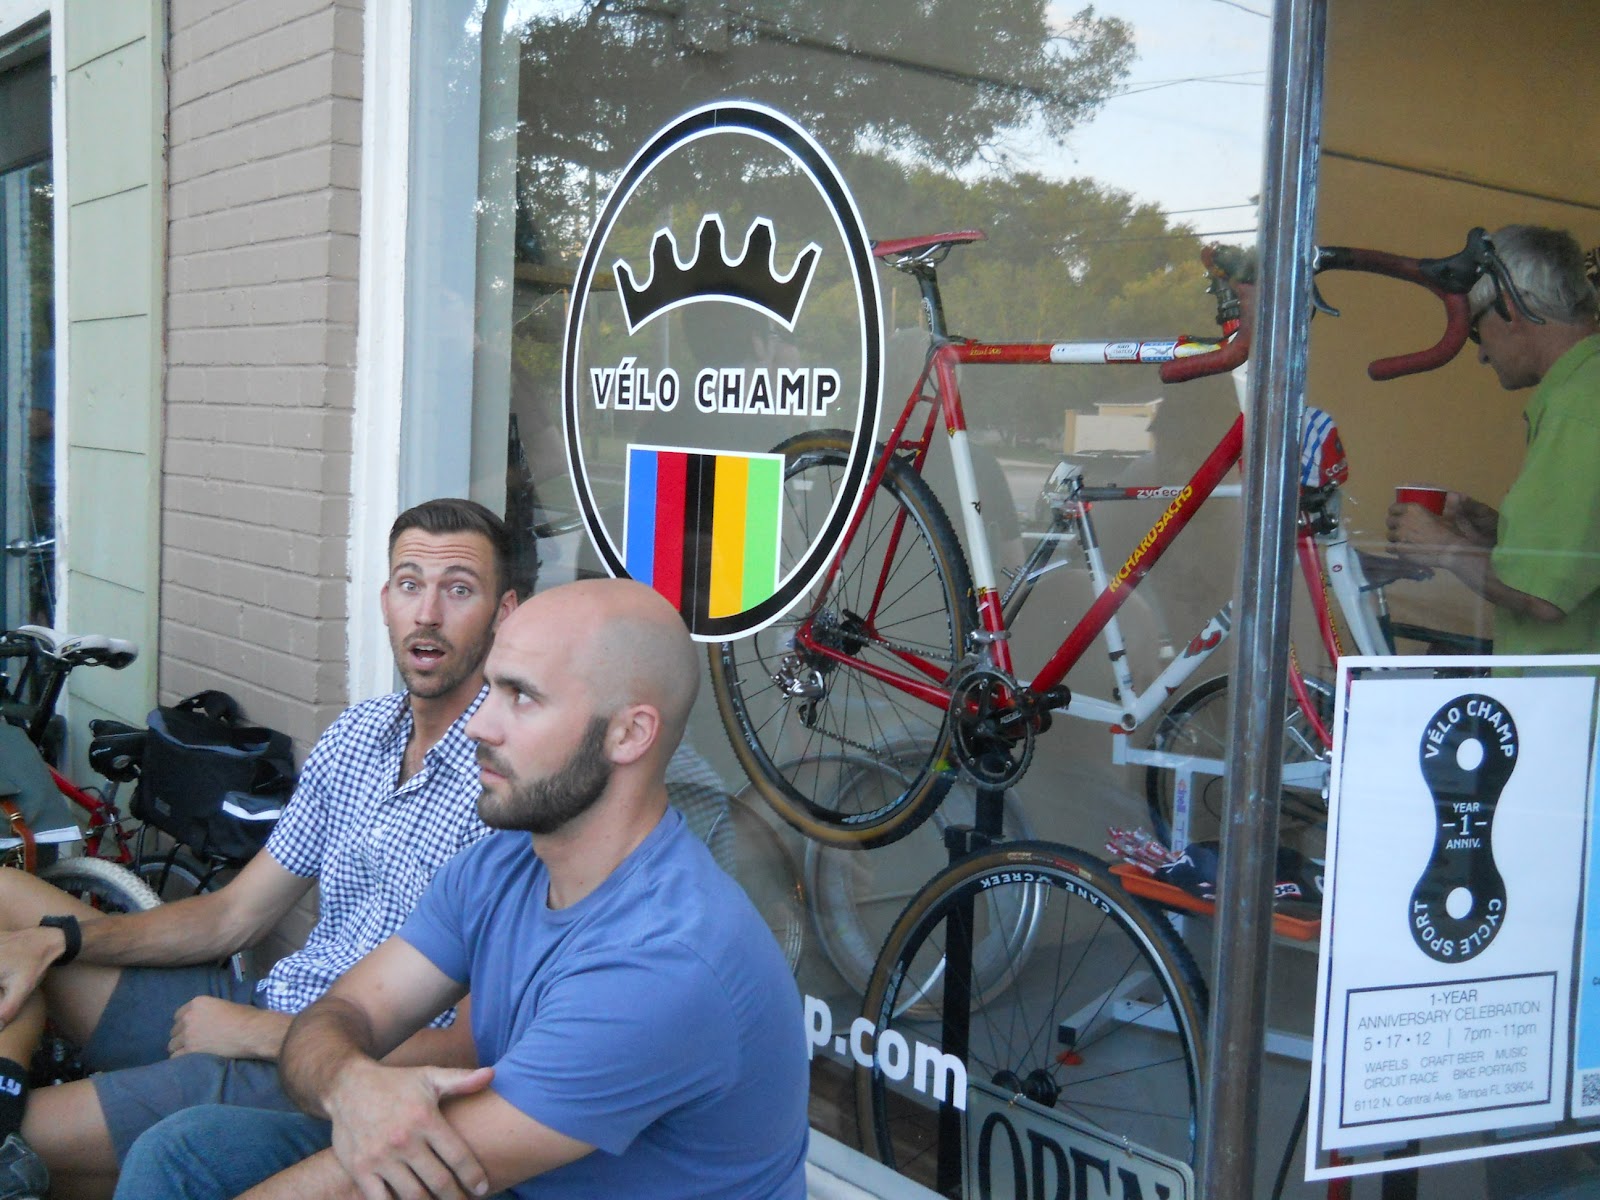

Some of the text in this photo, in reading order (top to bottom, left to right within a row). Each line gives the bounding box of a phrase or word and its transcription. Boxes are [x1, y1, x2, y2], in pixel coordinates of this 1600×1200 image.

[590, 357, 841, 416] VÉLO CHAMP
[1425, 700, 1513, 758] VÉLO CHAMP
[1453, 802, 1480, 813] YEAR
[1446, 838, 1480, 849] ANNIV.
[980, 872, 1110, 914] CANE CREEK
[1414, 898, 1502, 956] CYCLE SPORT
[1430, 989, 1478, 1006] 1-YEAR
[1358, 1001, 1540, 1030] ANNIVERSARY CELEBRATION
[1365, 1046, 1528, 1073] WAFELS CRAFT BEER MUSIC
[1364, 1074, 1407, 1090] CIRCUIT
[1410, 1071, 1439, 1085] RACE
[1453, 1068, 1476, 1080] BIKE
[1354, 1098, 1380, 1111] 6112
[1397, 1092, 1431, 1106] Central
[1458, 1088, 1488, 1100] Tampa
[1490, 1084, 1501, 1095] FL
